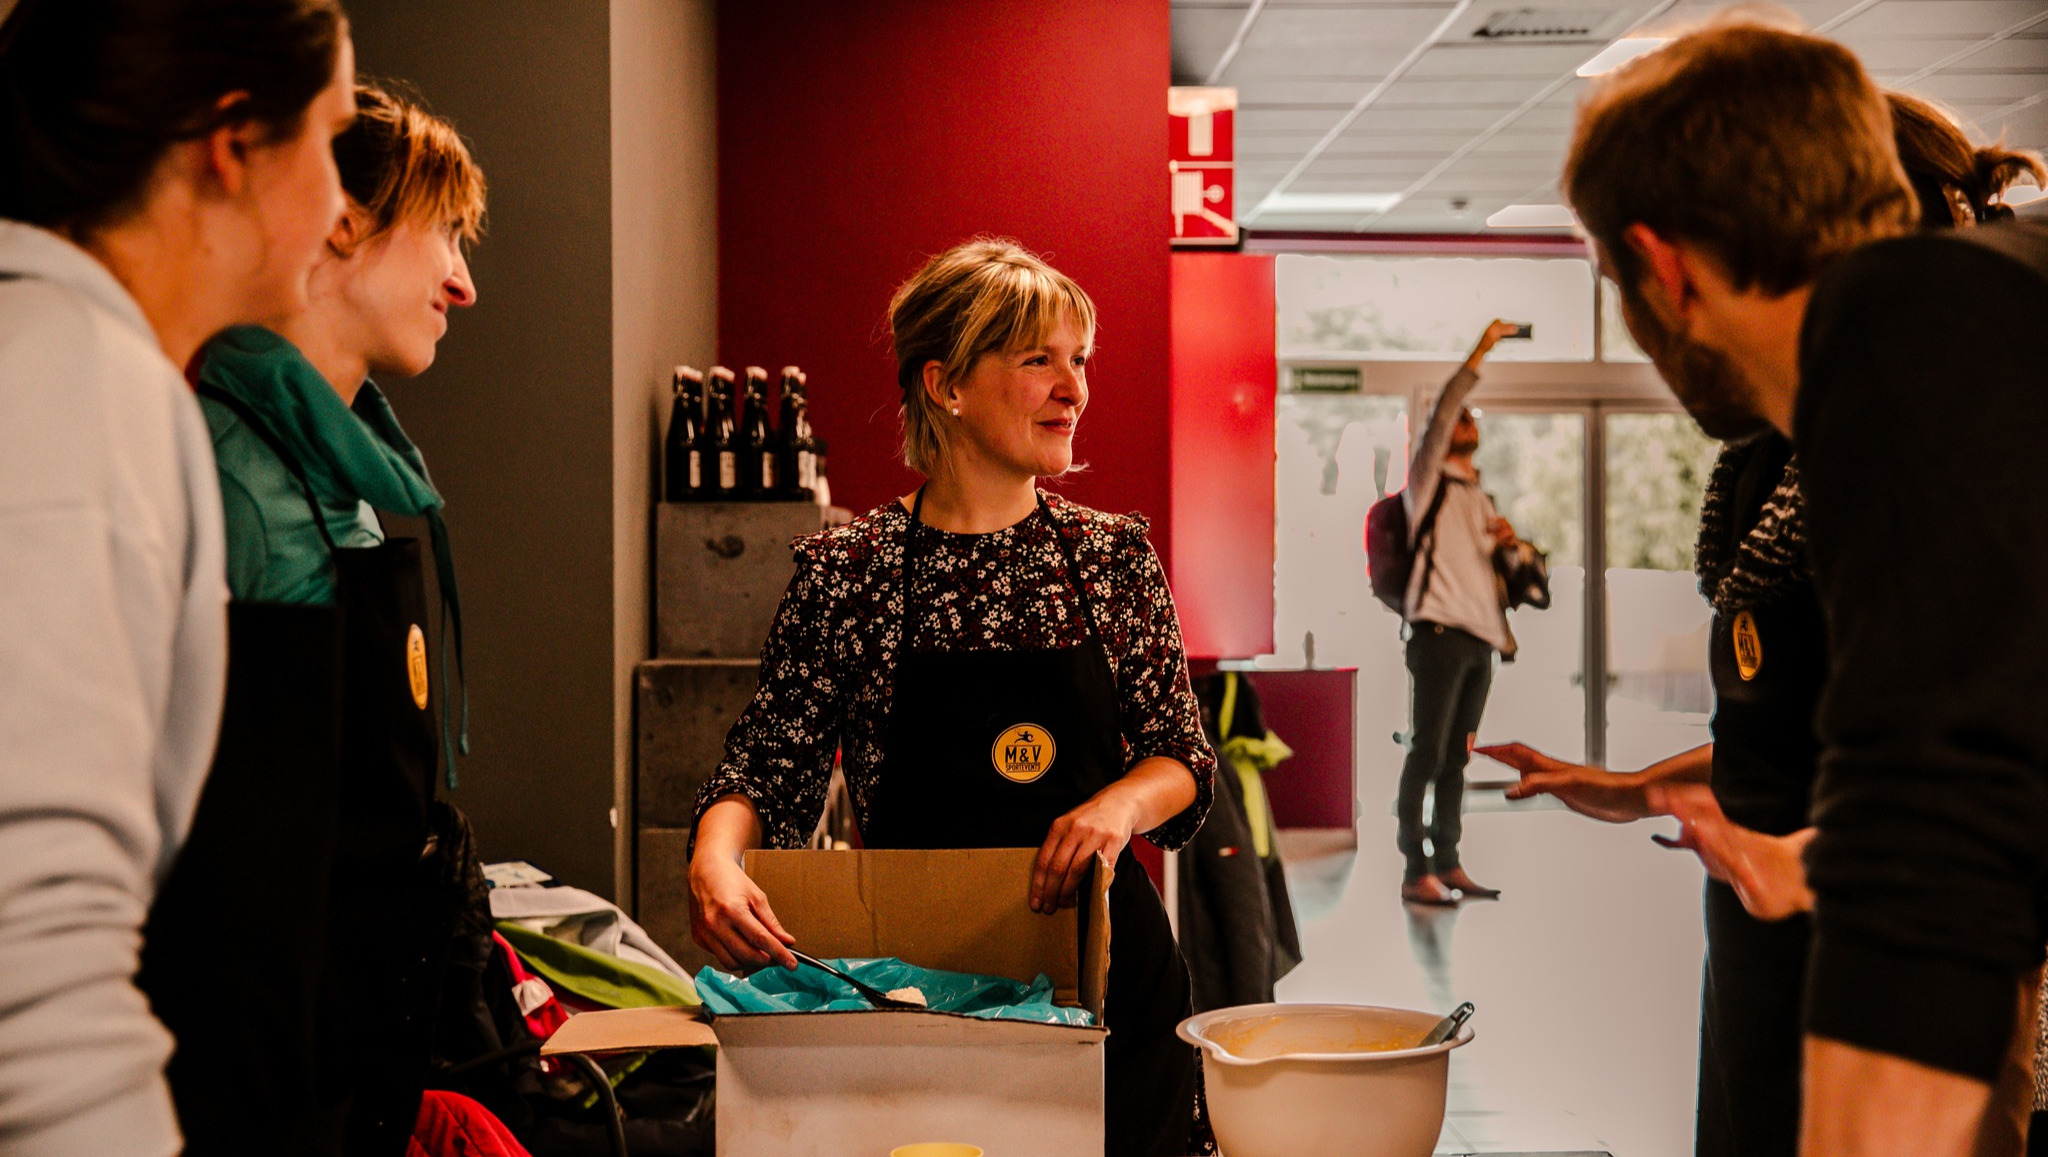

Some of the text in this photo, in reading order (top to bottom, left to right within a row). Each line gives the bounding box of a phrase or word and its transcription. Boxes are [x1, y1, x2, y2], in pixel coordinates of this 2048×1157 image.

[1005, 746, 1041, 763] M & V
